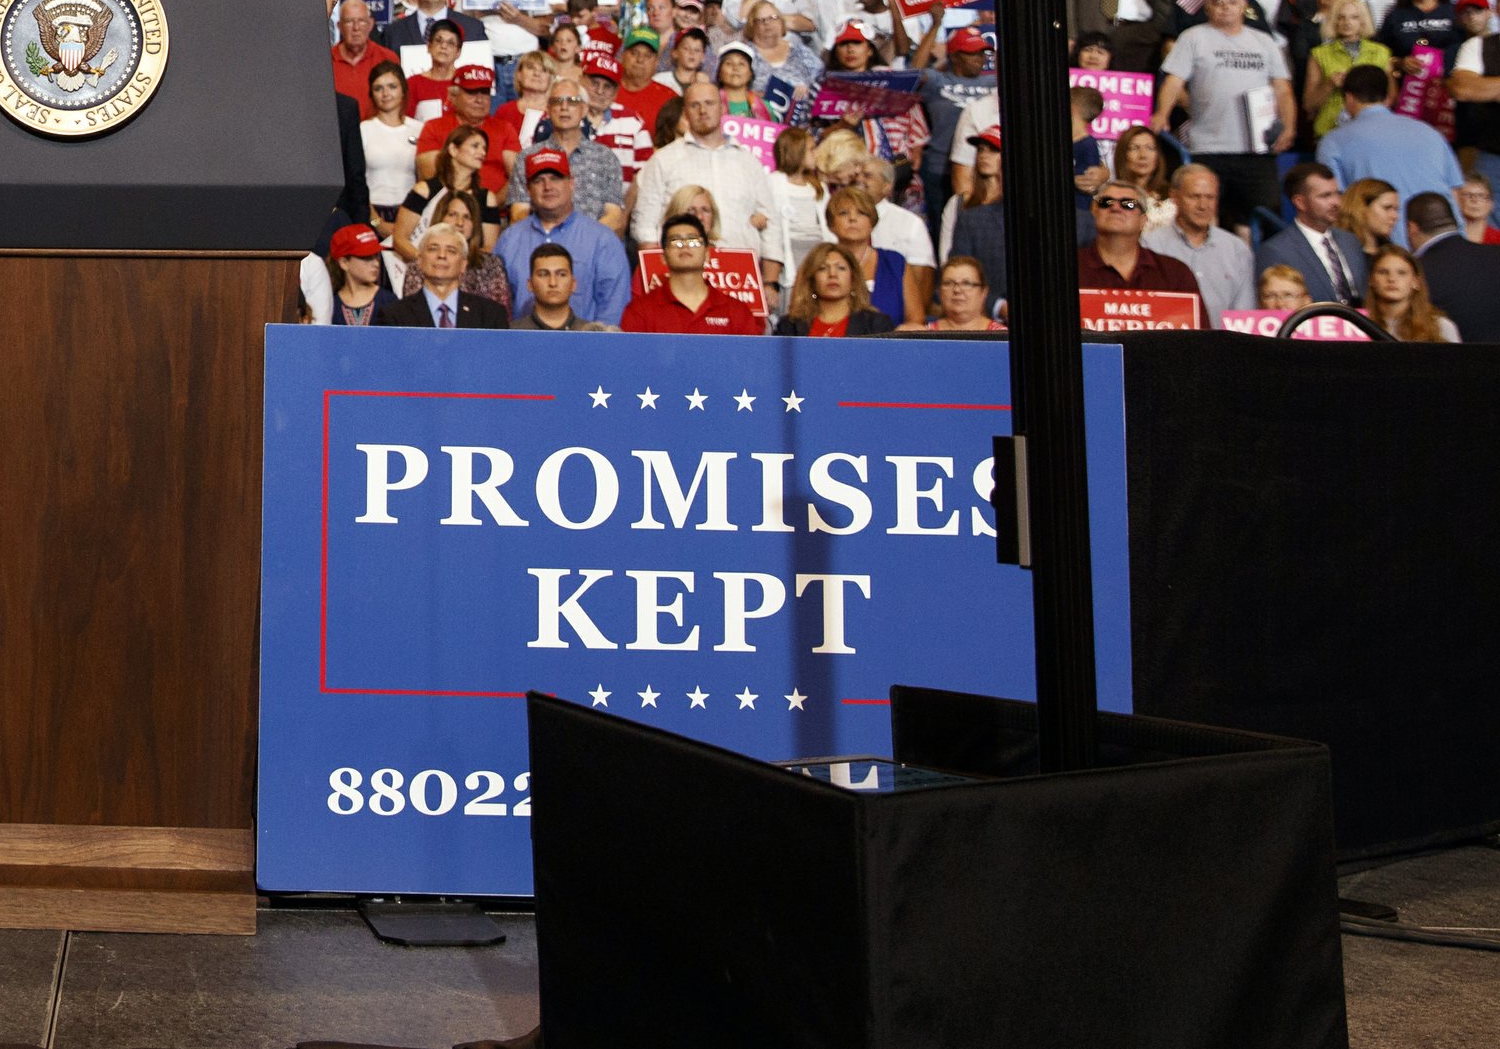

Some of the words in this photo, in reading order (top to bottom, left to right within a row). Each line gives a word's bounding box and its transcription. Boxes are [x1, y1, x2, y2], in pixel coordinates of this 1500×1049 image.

[597, 57, 618, 74] USA
[3, 85, 51, 125] SEAL
[85, 72, 152, 127] STATES
[1103, 99, 1121, 112] OR
[723, 119, 777, 143] OME
[1091, 118, 1147, 134] UMP
[648, 271, 760, 290] ARICA
[1104, 302, 1152, 317] MAKE
[1082, 317, 1191, 331] MERICA
[526, 567, 871, 655] KEPT
